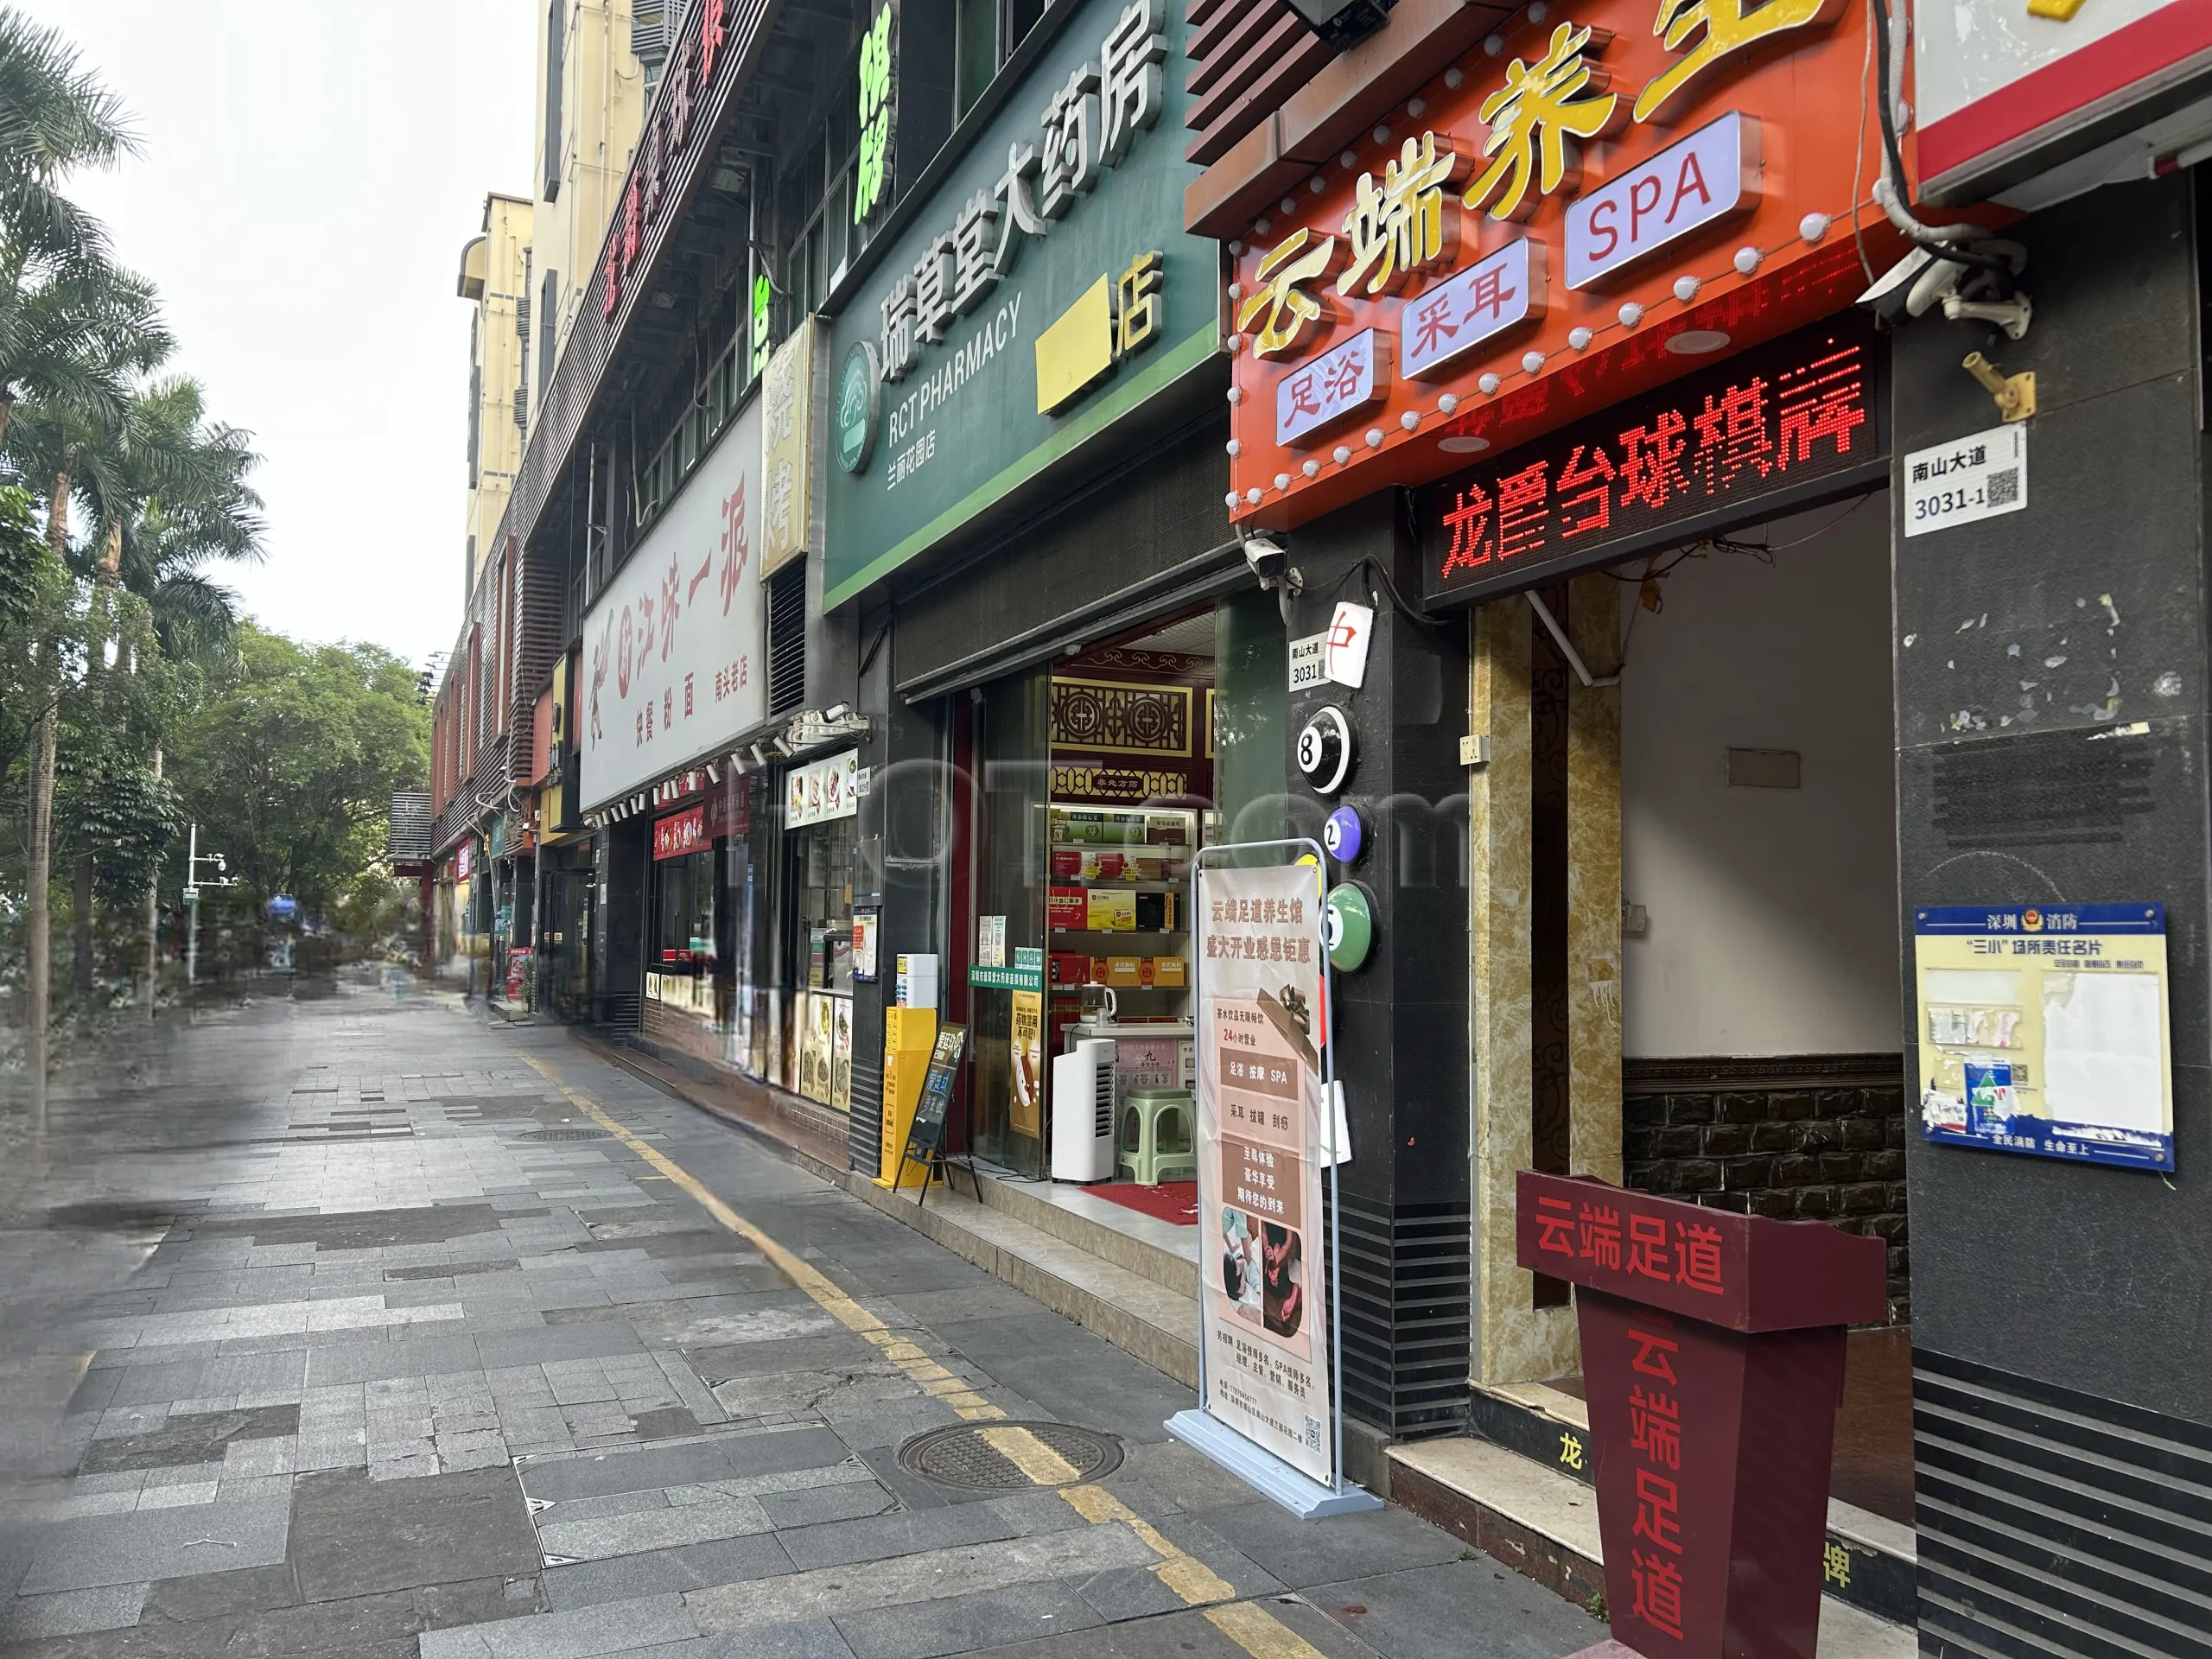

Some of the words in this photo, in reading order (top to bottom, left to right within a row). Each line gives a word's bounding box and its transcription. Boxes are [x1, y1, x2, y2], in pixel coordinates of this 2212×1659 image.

[880, 0, 1167, 382] 瑞草堂大药房
[1588, 151, 1712, 262] SPA
[1412, 262, 1517, 359] 采耳
[889, 391, 918, 448] RCT
[919, 292, 1021, 421] PHARMACY
[1284, 350, 1364, 429] 足浴
[887, 429, 936, 491] 兰丽花园店
[1442, 339, 1866, 580] 龙爵台球棋牌
[1912, 444, 1986, 482] 南山大道
[1915, 487, 1985, 519] 3031-1
[1293, 643, 1319, 660] 南山大道
[715, 653, 747, 703] 南头老店
[1294, 667, 1318, 683] 3031
[684, 672, 694, 719] 面
[1300, 733, 1313, 765] 8
[1096, 778, 1139, 790] 非处方药
[1327, 823, 1337, 845] 2
[1211, 898, 1303, 925] 云端足道养生馆
[1987, 914, 2018, 931] 深圳
[2046, 913, 2078, 931] 消防
[1207, 935, 1311, 963] 盛大开业感恩钜惠
[1217, 1008, 1264, 1026] 茶水饮品无限畅饮
[1224, 1028, 1256, 1046] 24小时营业
[1230, 1062, 1244, 1077] 足浴
[1249, 1065, 1265, 1081] 按摩
[1271, 1069, 1287, 1084] SPA
[1230, 1104, 1244, 1120] 采耳
[1249, 1109, 1265, 1126] 拔罐
[1272, 1114, 1289, 1130] 刮痧
[1243, 1146, 1274, 1167] 至尊体验
[1992, 1134, 2036, 1149] 全民消防
[2044, 1139, 2089, 1156] 生命至上
[1243, 1172, 1275, 1191] 豪华享受
[1236, 1186, 1285, 1215] 期待您的到来
[1535, 1196, 1726, 1296] 云端足道
[1627, 1310, 1684, 1642] 云端足道
[1560, 1432, 1582, 1470] 龙
[1823, 1541, 1851, 1588] 牌
